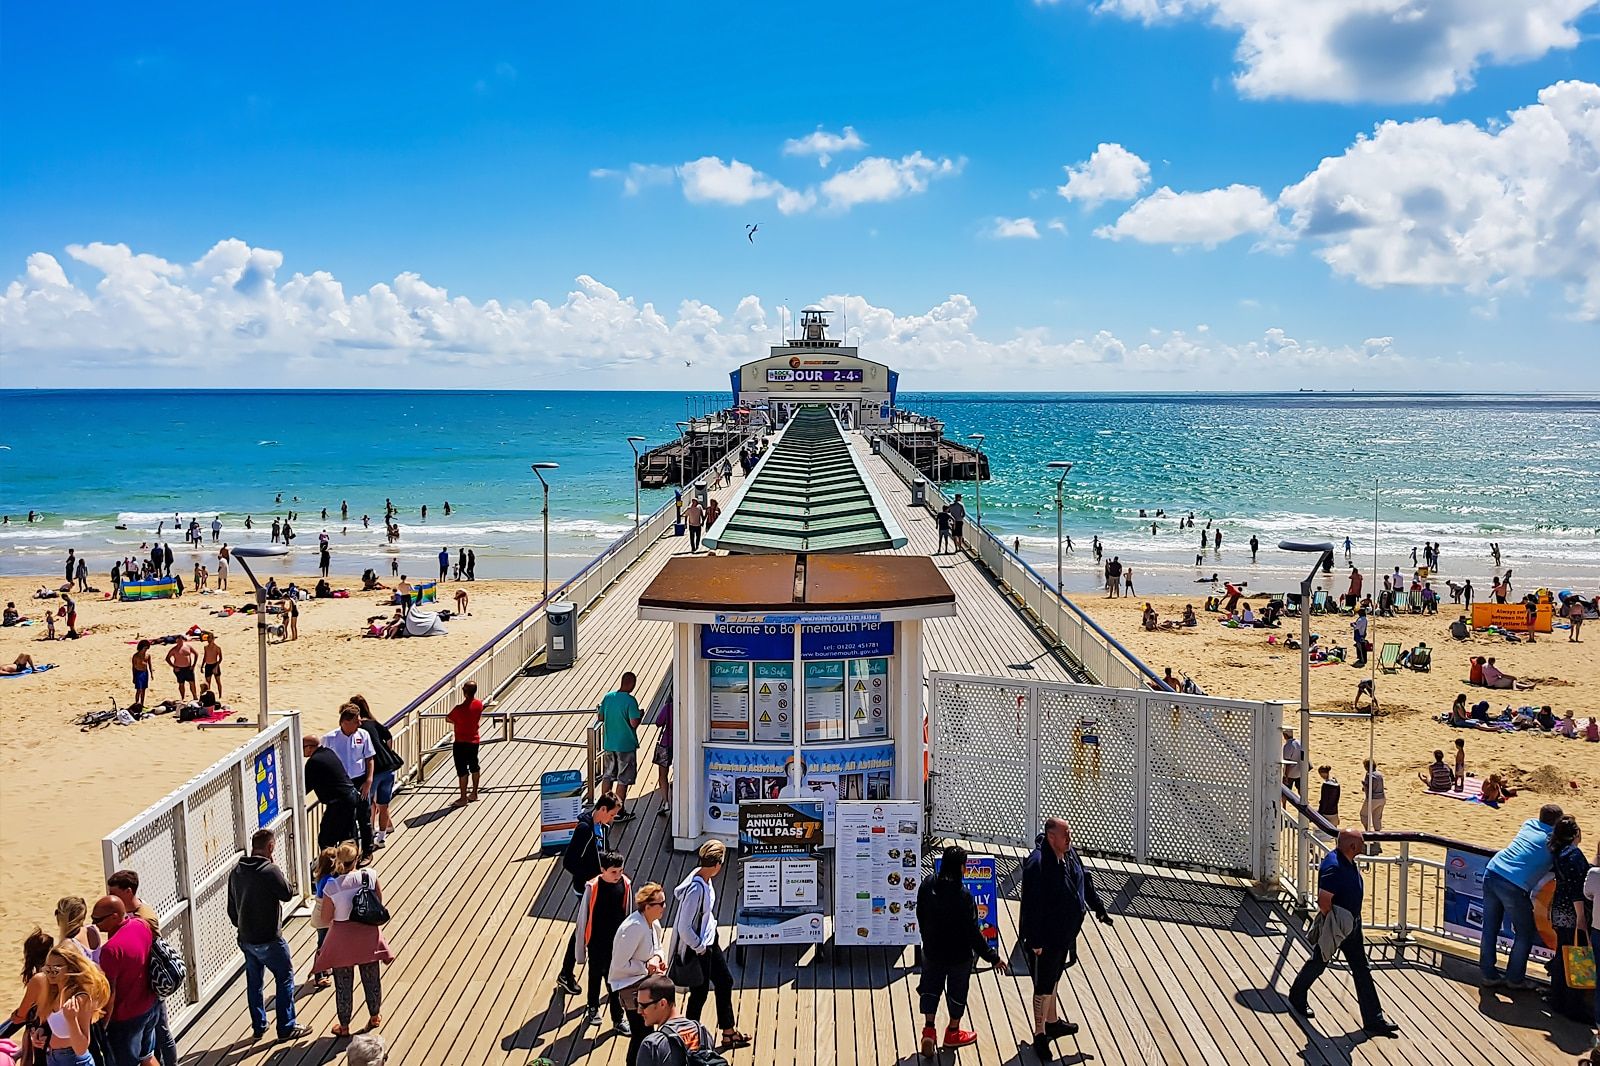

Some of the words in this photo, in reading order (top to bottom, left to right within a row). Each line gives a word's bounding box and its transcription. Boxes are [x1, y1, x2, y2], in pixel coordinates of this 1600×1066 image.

[710, 623, 760, 634] Welcome
[764, 625, 776, 634] to
[780, 622, 857, 634] Bornemouth
[861, 621, 882, 631] Pier
[715, 665, 730, 675] Pier
[731, 665, 745, 674] Toll
[759, 666, 769, 675] Be
[771, 666, 787, 677] Safe
[809, 666, 825, 675] Pier
[826, 664, 839, 673] Toll
[545, 774, 560, 784] Pier
[562, 771, 577, 780] Toll
[746, 818, 789, 828] ANNUAL
[746, 827, 773, 837] TOLL
[774, 827, 804, 837] PASS
[963, 866, 992, 879] FAIR
